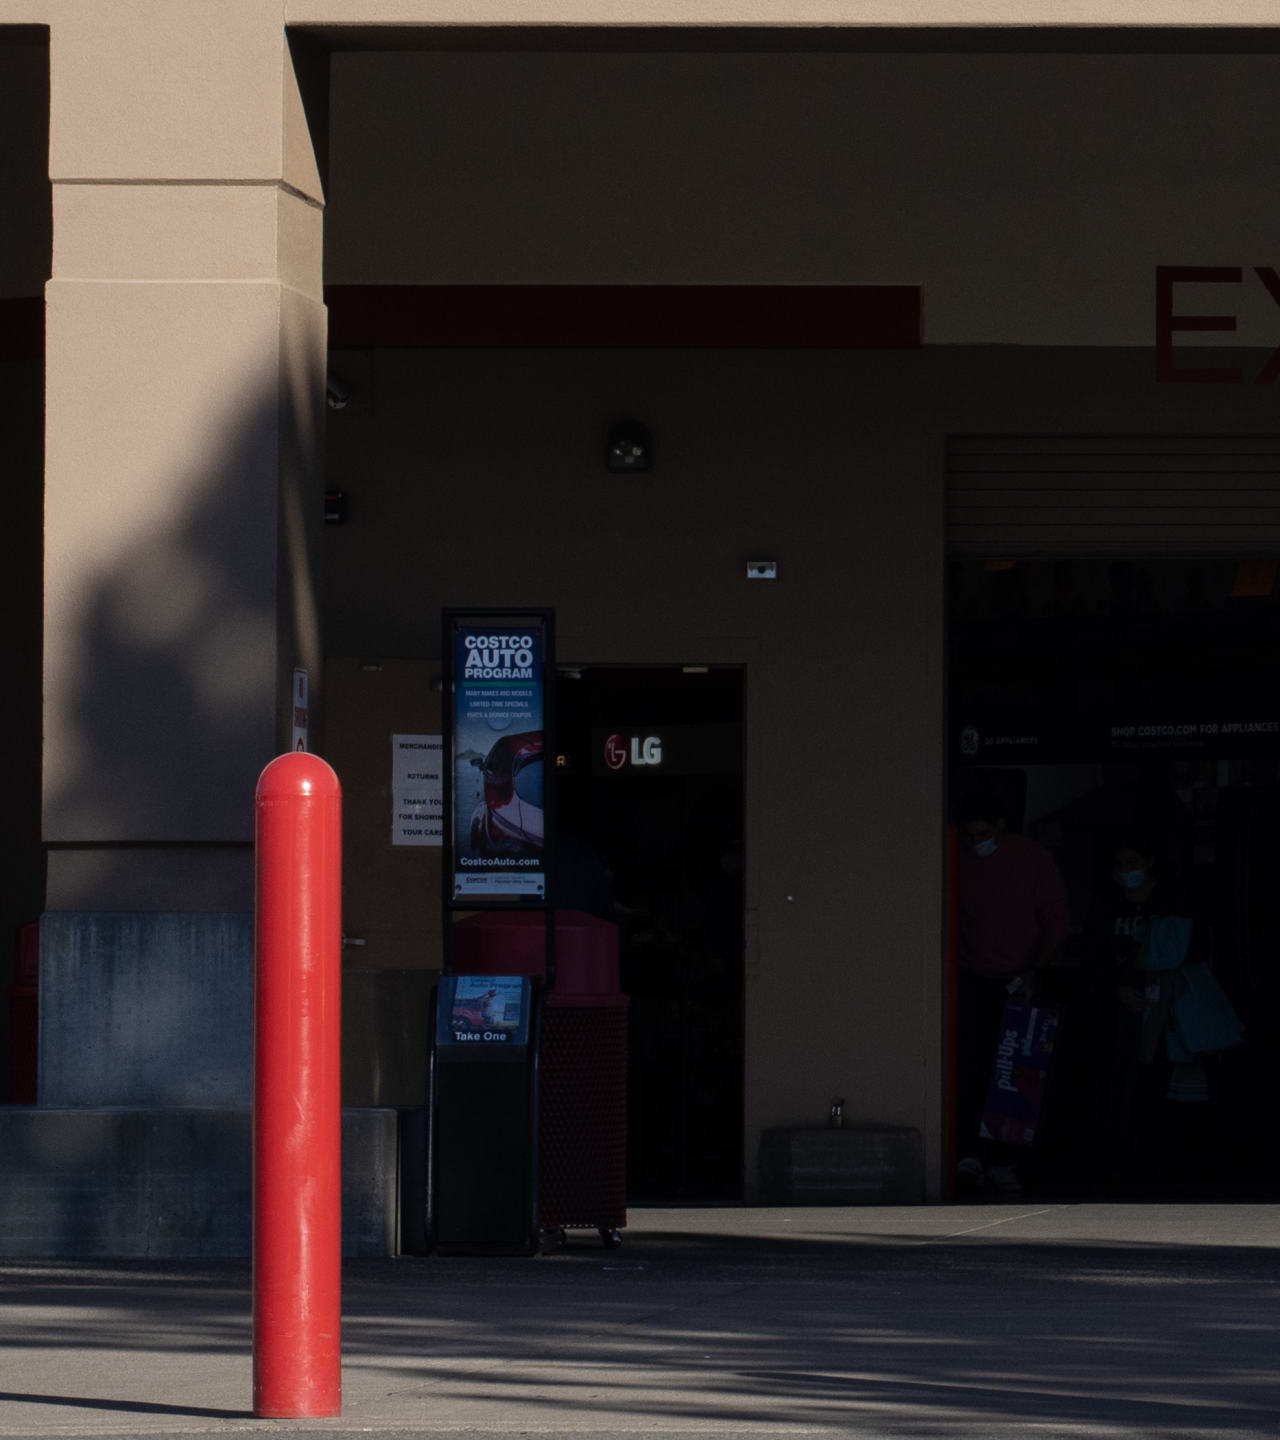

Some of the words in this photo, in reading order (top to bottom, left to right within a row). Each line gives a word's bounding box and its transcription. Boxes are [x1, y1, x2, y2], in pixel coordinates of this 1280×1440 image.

[464, 635, 533, 649] COSTCO
[465, 648, 534, 668] AUTO
[464, 668, 533, 679] PROGRAM
[1111, 726, 1136, 737] SHOP
[1138, 724, 1197, 736] COSTCO.COM
[1200, 723, 1219, 734] FOR
[1221, 721, 1279, 734] APPLIANCES
[631, 737, 662, 766] LG
[460, 857, 539, 866] CostcoAuto.com
[455, 1032, 481, 1040] Take
[483, 1032, 507, 1040] One
